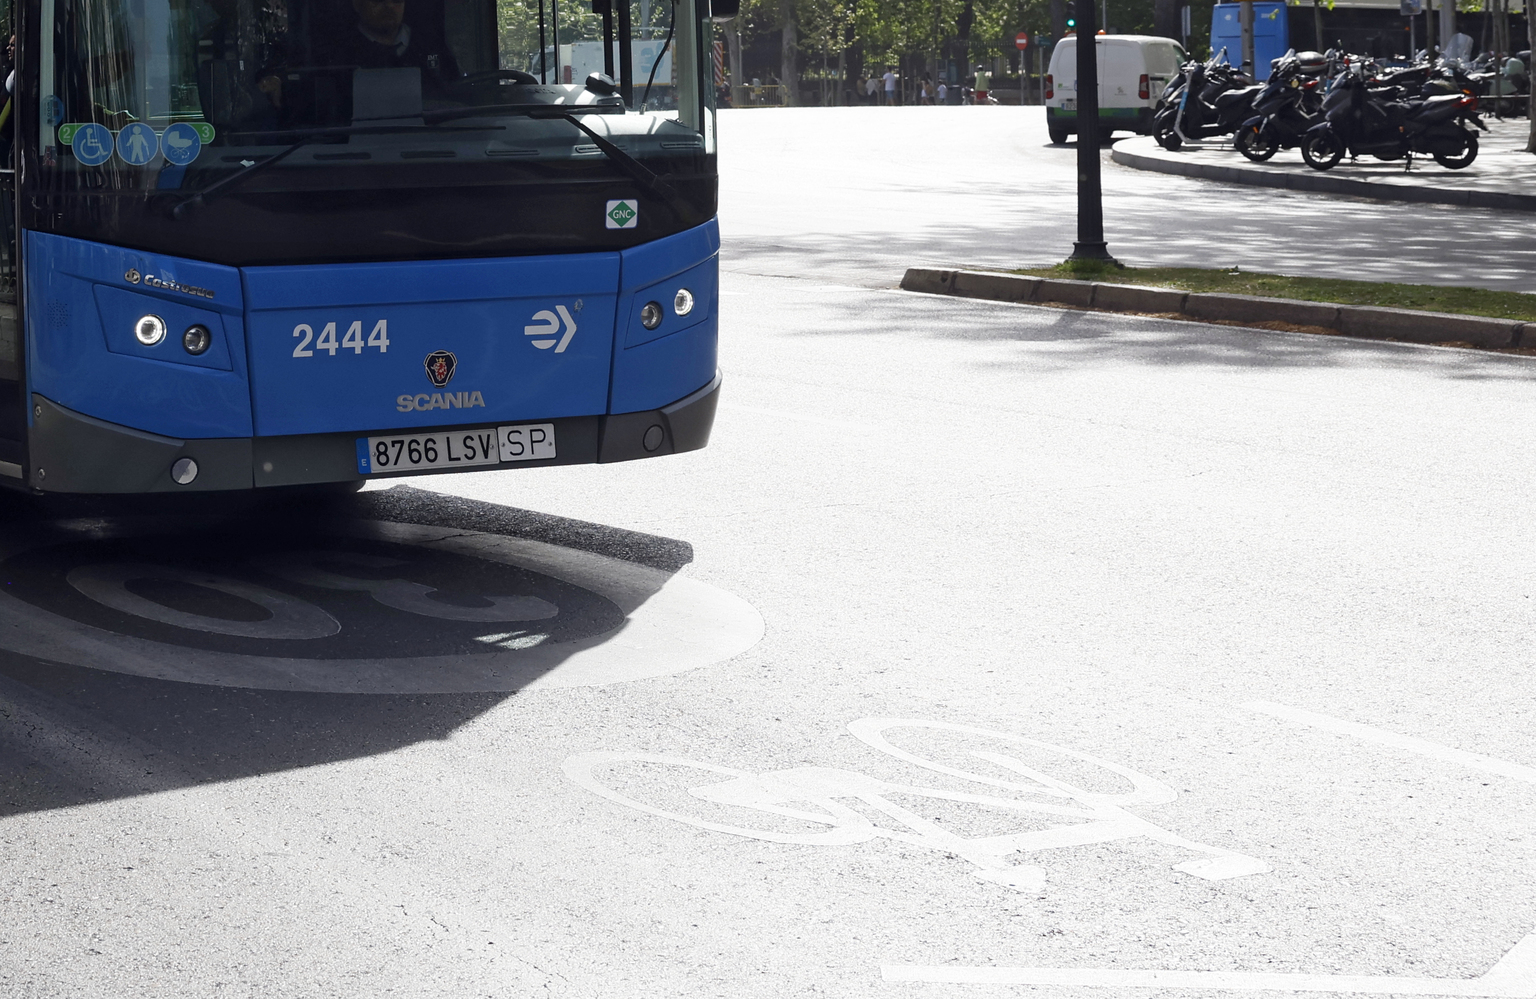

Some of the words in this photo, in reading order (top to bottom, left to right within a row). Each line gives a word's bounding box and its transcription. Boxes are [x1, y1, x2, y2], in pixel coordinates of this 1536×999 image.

[63, 127, 71, 139] 2
[202, 126, 210, 138] 3
[612, 209, 632, 219] GNC
[292, 319, 390, 358] 2444
[395, 390, 486, 412] SCANIA
[375, 437, 439, 467] 8766
[446, 433, 492, 463] LSV
[506, 428, 547, 456] SP
